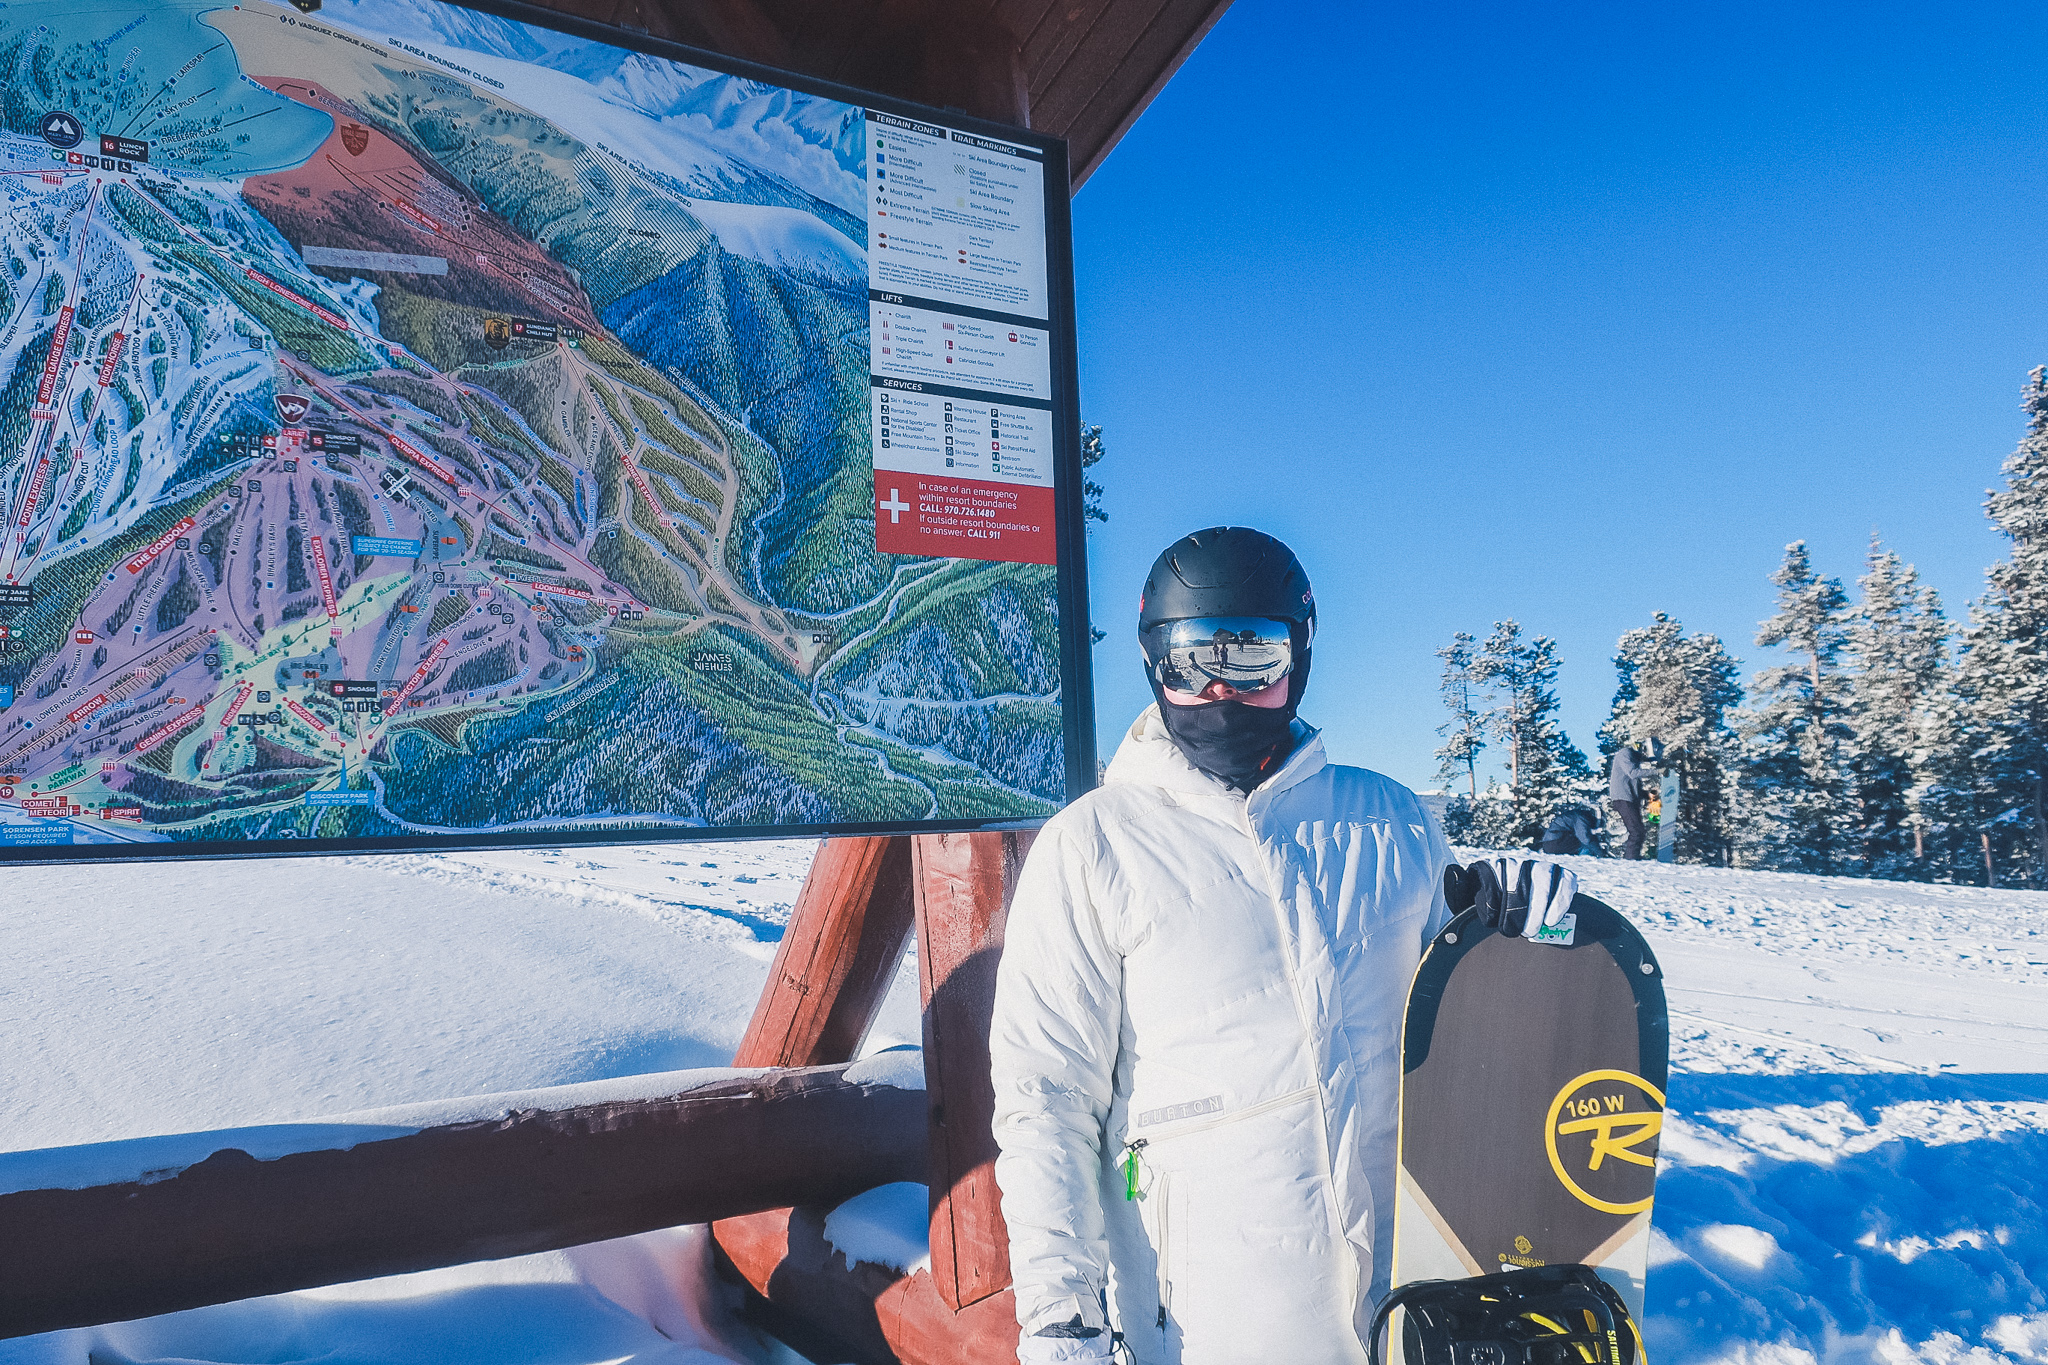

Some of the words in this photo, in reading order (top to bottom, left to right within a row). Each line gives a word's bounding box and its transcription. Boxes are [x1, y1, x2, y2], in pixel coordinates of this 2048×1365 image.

[298, 20, 332, 36] VASQUEZ
[333, 32, 359, 46] CIRQUE
[361, 42, 388, 58] ACCESS
[388, 37, 402, 49] SKI
[404, 44, 426, 58] AREA
[428, 53, 472, 77] BOUNDARY
[473, 72, 504, 90] CLOSED
[165, 106, 178, 115] SKY
[180, 96, 198, 109] PILOT
[876, 114, 910, 129] TERRAIN
[912, 124, 940, 136] ZONES
[104, 141, 114, 150] 16
[120, 142, 145, 151] LUNCH
[120, 147, 140, 156] ROCK
[954, 134, 975, 145] TRAIL
[976, 140, 1016, 156] MARKINGS
[596, 141, 608, 153] SKI
[608, 151, 628, 166] AREA
[628, 163, 664, 190] BOUNDARY
[666, 186, 692, 208] CLOSED
[57, 216, 70, 234] SIDE
[66, 200, 82, 220] TRACK
[249, 270, 269, 287] HIGH
[270, 280, 311, 310] LONESOME
[312, 304, 348, 330] EXPRESS
[881, 293, 902, 303] LIFTS
[0, 325, 18, 350] SLEEPER
[526, 324, 556, 332] SUNDANCE
[40, 375, 52, 400] SUPER
[48, 346, 61, 374] GAUGE
[58, 310, 72, 346] EXPRESS
[100, 365, 112, 384] IRON
[108, 338, 122, 364] HORSE
[883, 378, 922, 391] SERVICES
[326, 434, 356, 442] SUNSPOT
[391, 438, 420, 461] OLYMPIA
[418, 456, 450, 482] EXPRESS
[22, 501, 34, 524] PONY
[30, 463, 48, 500] EXPRESS
[623, 458, 642, 486] PIONEER
[640, 485, 662, 514] EXPRESS
[918, 482, 926, 490] In
[928, 484, 948, 492] case
[950, 485, 958, 494] of
[974, 488, 1018, 501] emergency
[919, 493, 944, 503] within
[946, 496, 970, 506] resort
[972, 498, 1017, 510] boundaries
[920, 503, 942, 513] CALL:
[944, 506, 996, 518] 970.726.1480
[920, 526, 931, 534] no
[967, 528, 988, 539] CALL
[989, 530, 1000, 540] 911
[927, 516, 958, 526] outside
[960, 518, 984, 528] resort
[986, 520, 1030, 532] boundaries
[40, 550, 59, 562] MARY
[62, 542, 80, 554] JANE
[132, 555, 146, 569] THE
[149, 521, 190, 556] GONDOLA
[312, 540, 329, 579] EXPLORER
[321, 579, 337, 615] EXPRESS
[376, 583, 400, 597] VILLAGE
[398, 575, 412, 585] WAY
[534, 583, 566, 594] LOOKING
[568, 588, 592, 598] GLASS
[374, 656, 388, 674] DARK
[384, 620, 404, 654] TERRITORY
[694, 652, 732, 662] JAMES
[387, 673, 422, 716] PROSPECTOR
[422, 642, 446, 671] EXPRESS
[694, 662, 732, 672] NIEHUES
[36, 703, 60, 722] LOWER
[60, 686, 89, 711] HUGHES
[72, 696, 104, 720] ARROW
[545, 712, 560, 722] SKI
[560, 698, 580, 714] AREA
[578, 672, 620, 702] BOUNDARY
[134, 709, 164, 726] AMBUSH
[140, 729, 167, 750] GEMINI
[166, 706, 203, 732] EXPRESS
[290, 702, 322, 730] DISCOVERY
[48, 768, 88, 791] PARKWAY
[1141, 1096, 1220, 1127] BURTON
[1566, 1098, 1601, 1118] 160
[1603, 1094, 1625, 1113] W
